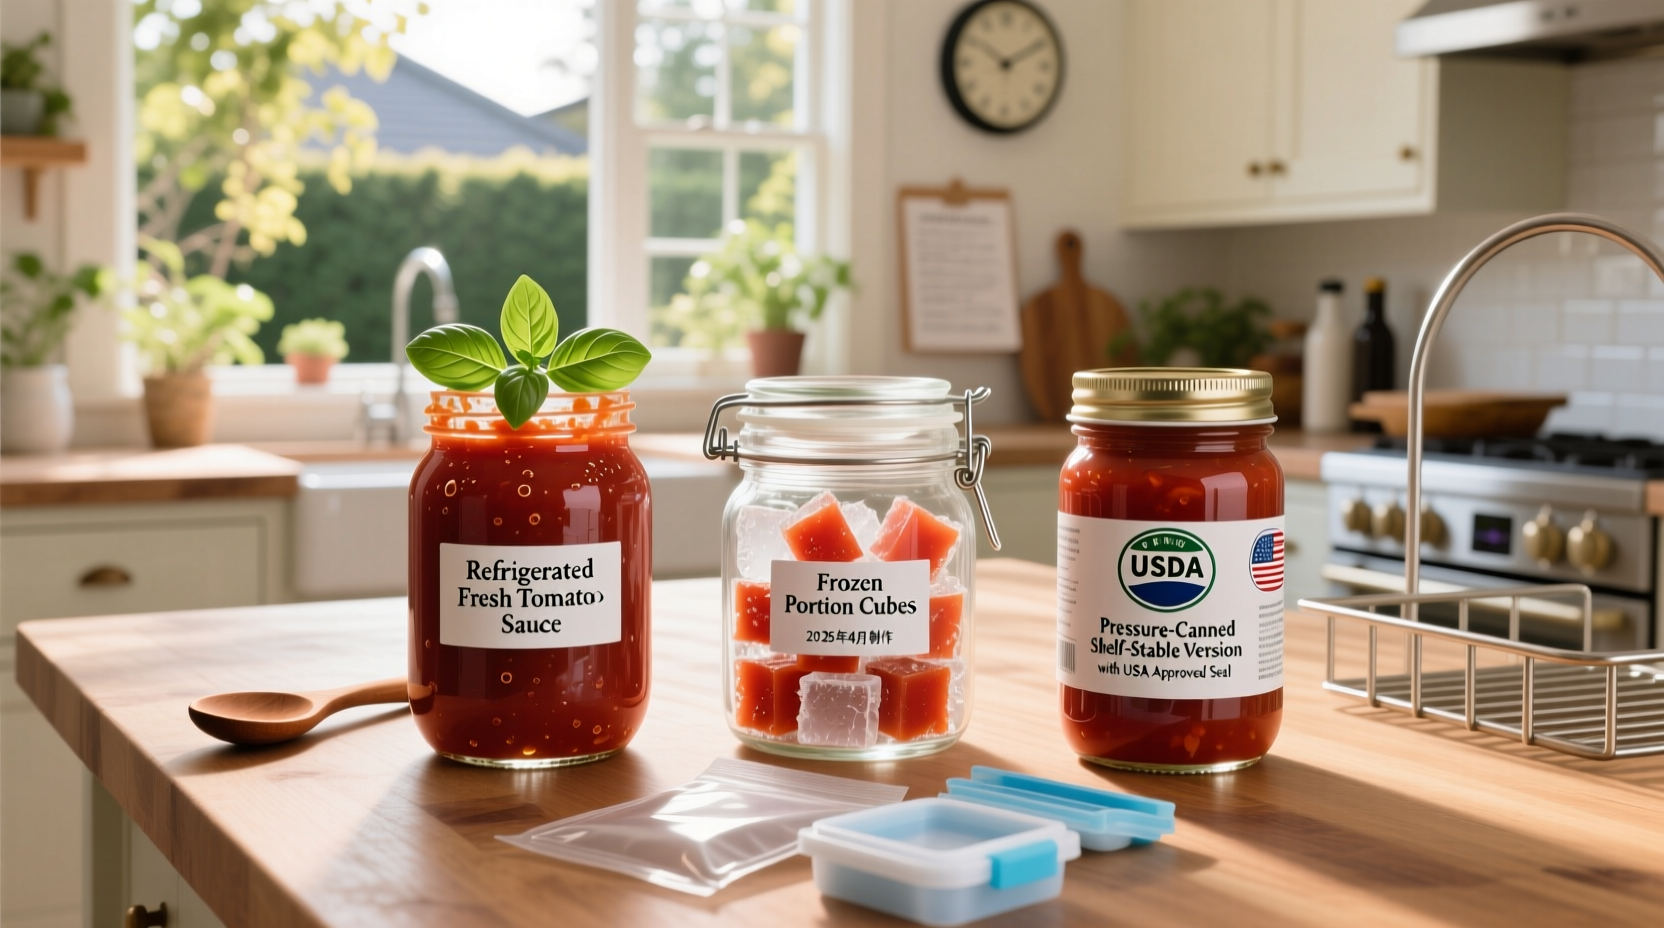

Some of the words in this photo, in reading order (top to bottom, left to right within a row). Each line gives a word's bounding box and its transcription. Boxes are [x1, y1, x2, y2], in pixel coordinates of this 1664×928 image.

[466, 558, 594, 586] Refrigerated
[1131, 554, 1204, 578] USDA
[816, 573, 883, 592] Frozen
[457, 587, 512, 607] Fresh
[784, 595, 854, 615] Portion
[859, 596, 917, 615] Cubes
[501, 613, 562, 634] Sauce
[1100, 617, 1235, 638] Pressure-Canned
[1183, 641, 1242, 658] Version
[1097, 661, 1120, 675] with
[1123, 664, 1149, 678] USA
[1151, 664, 1206, 682] Approved
